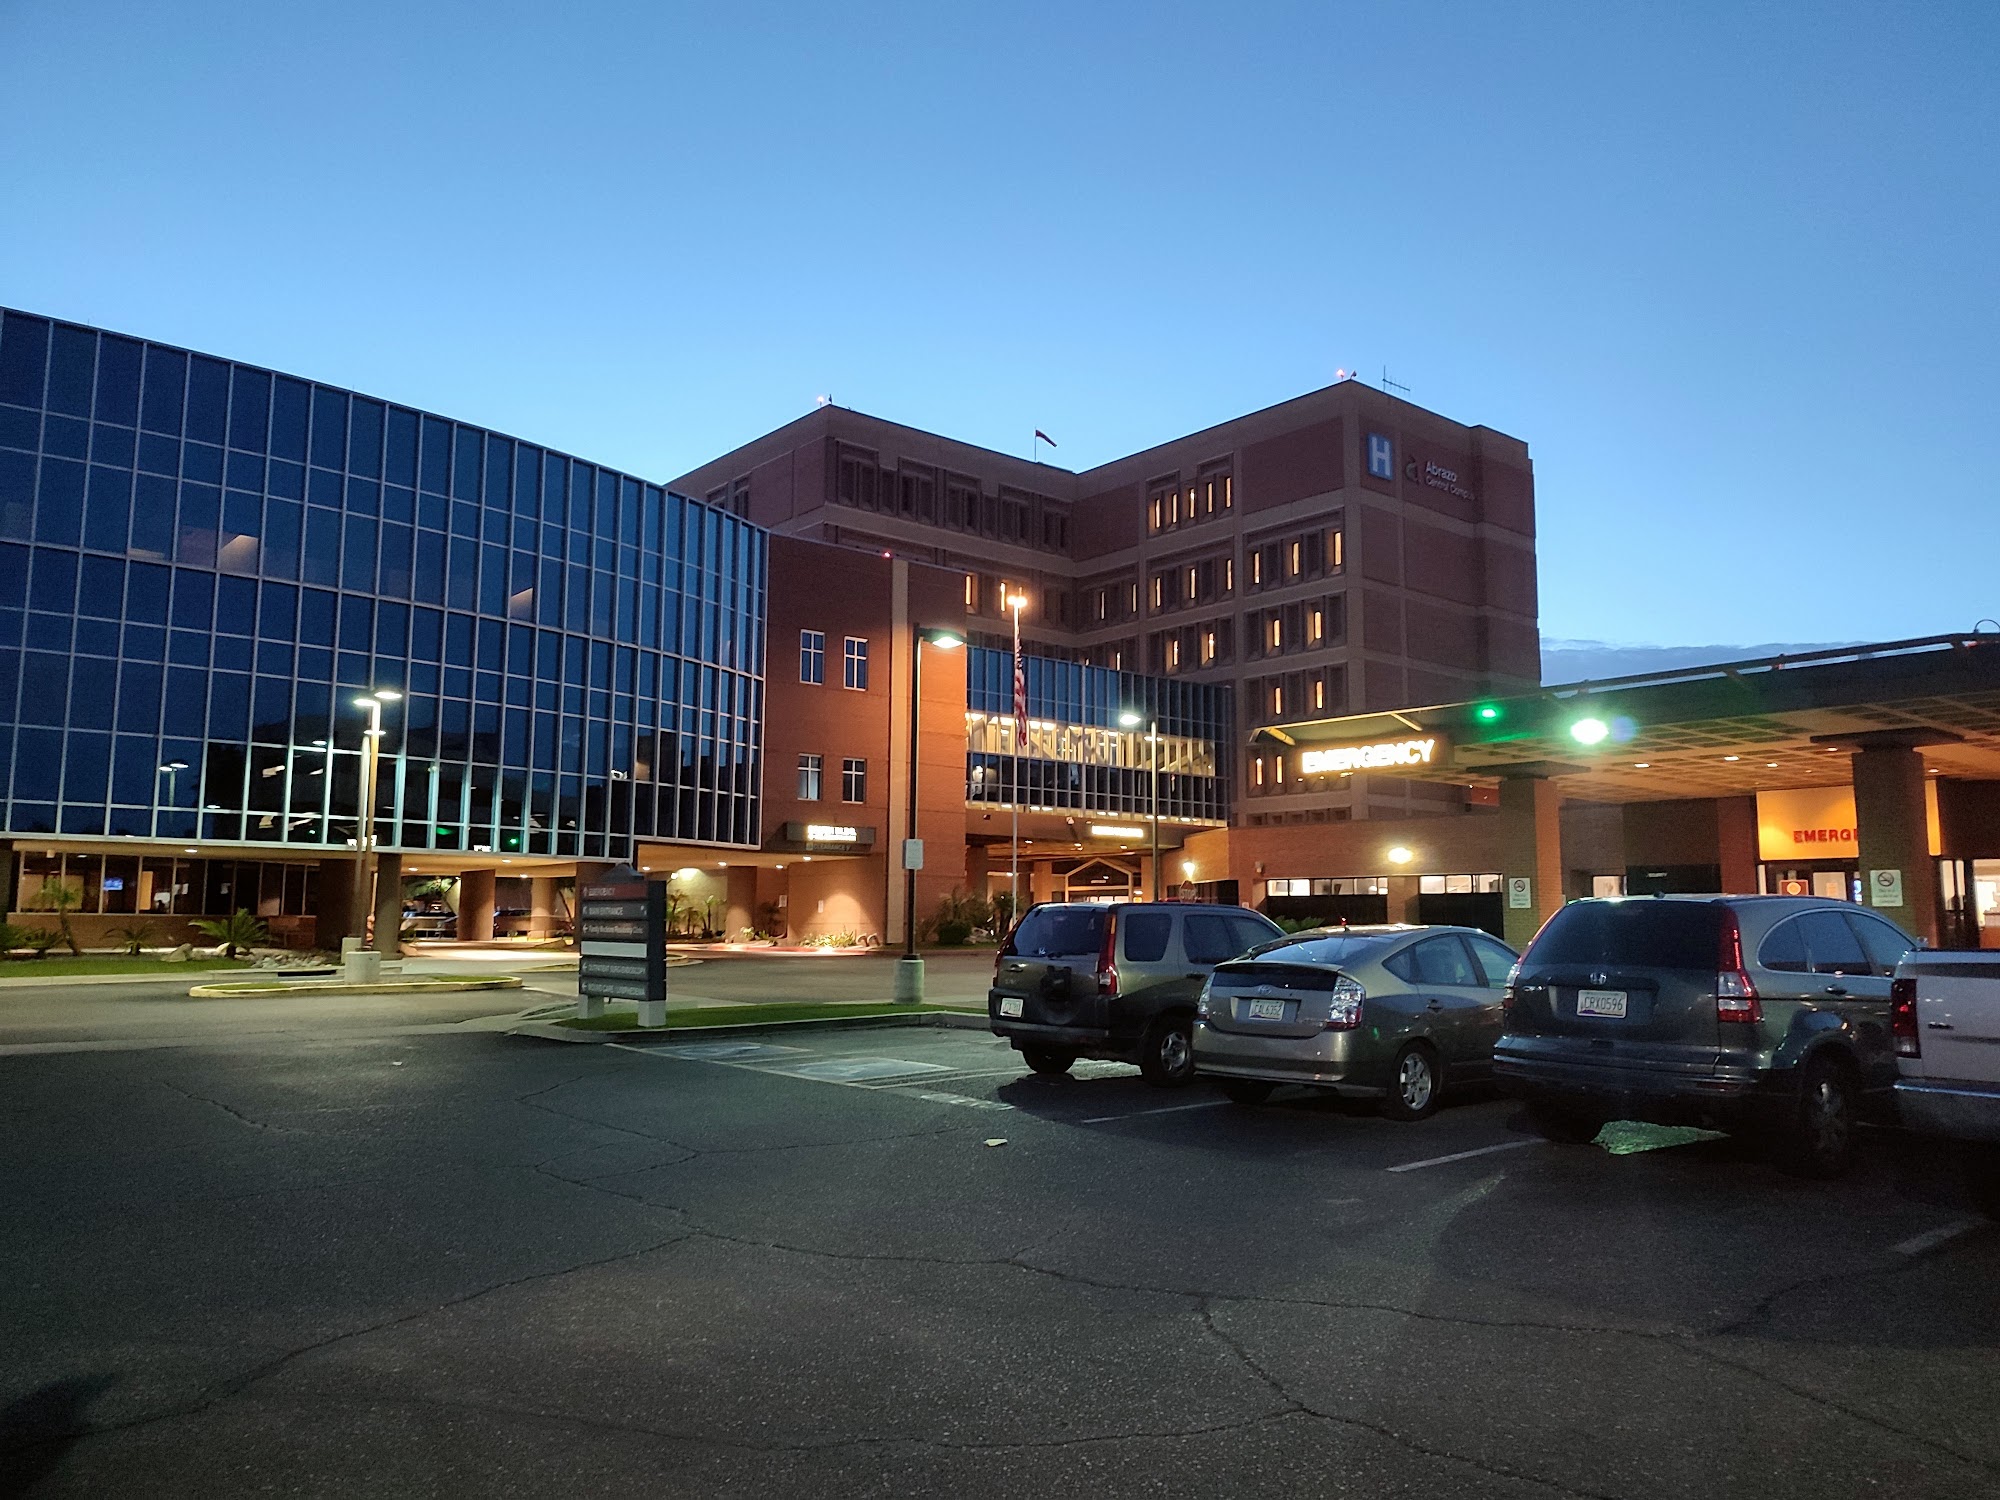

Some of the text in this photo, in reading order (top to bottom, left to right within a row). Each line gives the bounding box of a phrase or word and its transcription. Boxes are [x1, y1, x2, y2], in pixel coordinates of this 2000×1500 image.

[1371, 436, 1391, 476] H
[1426, 461, 1457, 482] Abrazo
[1302, 738, 1436, 774] EMERGENCY
[1584, 996, 1623, 1011] CRX0596
